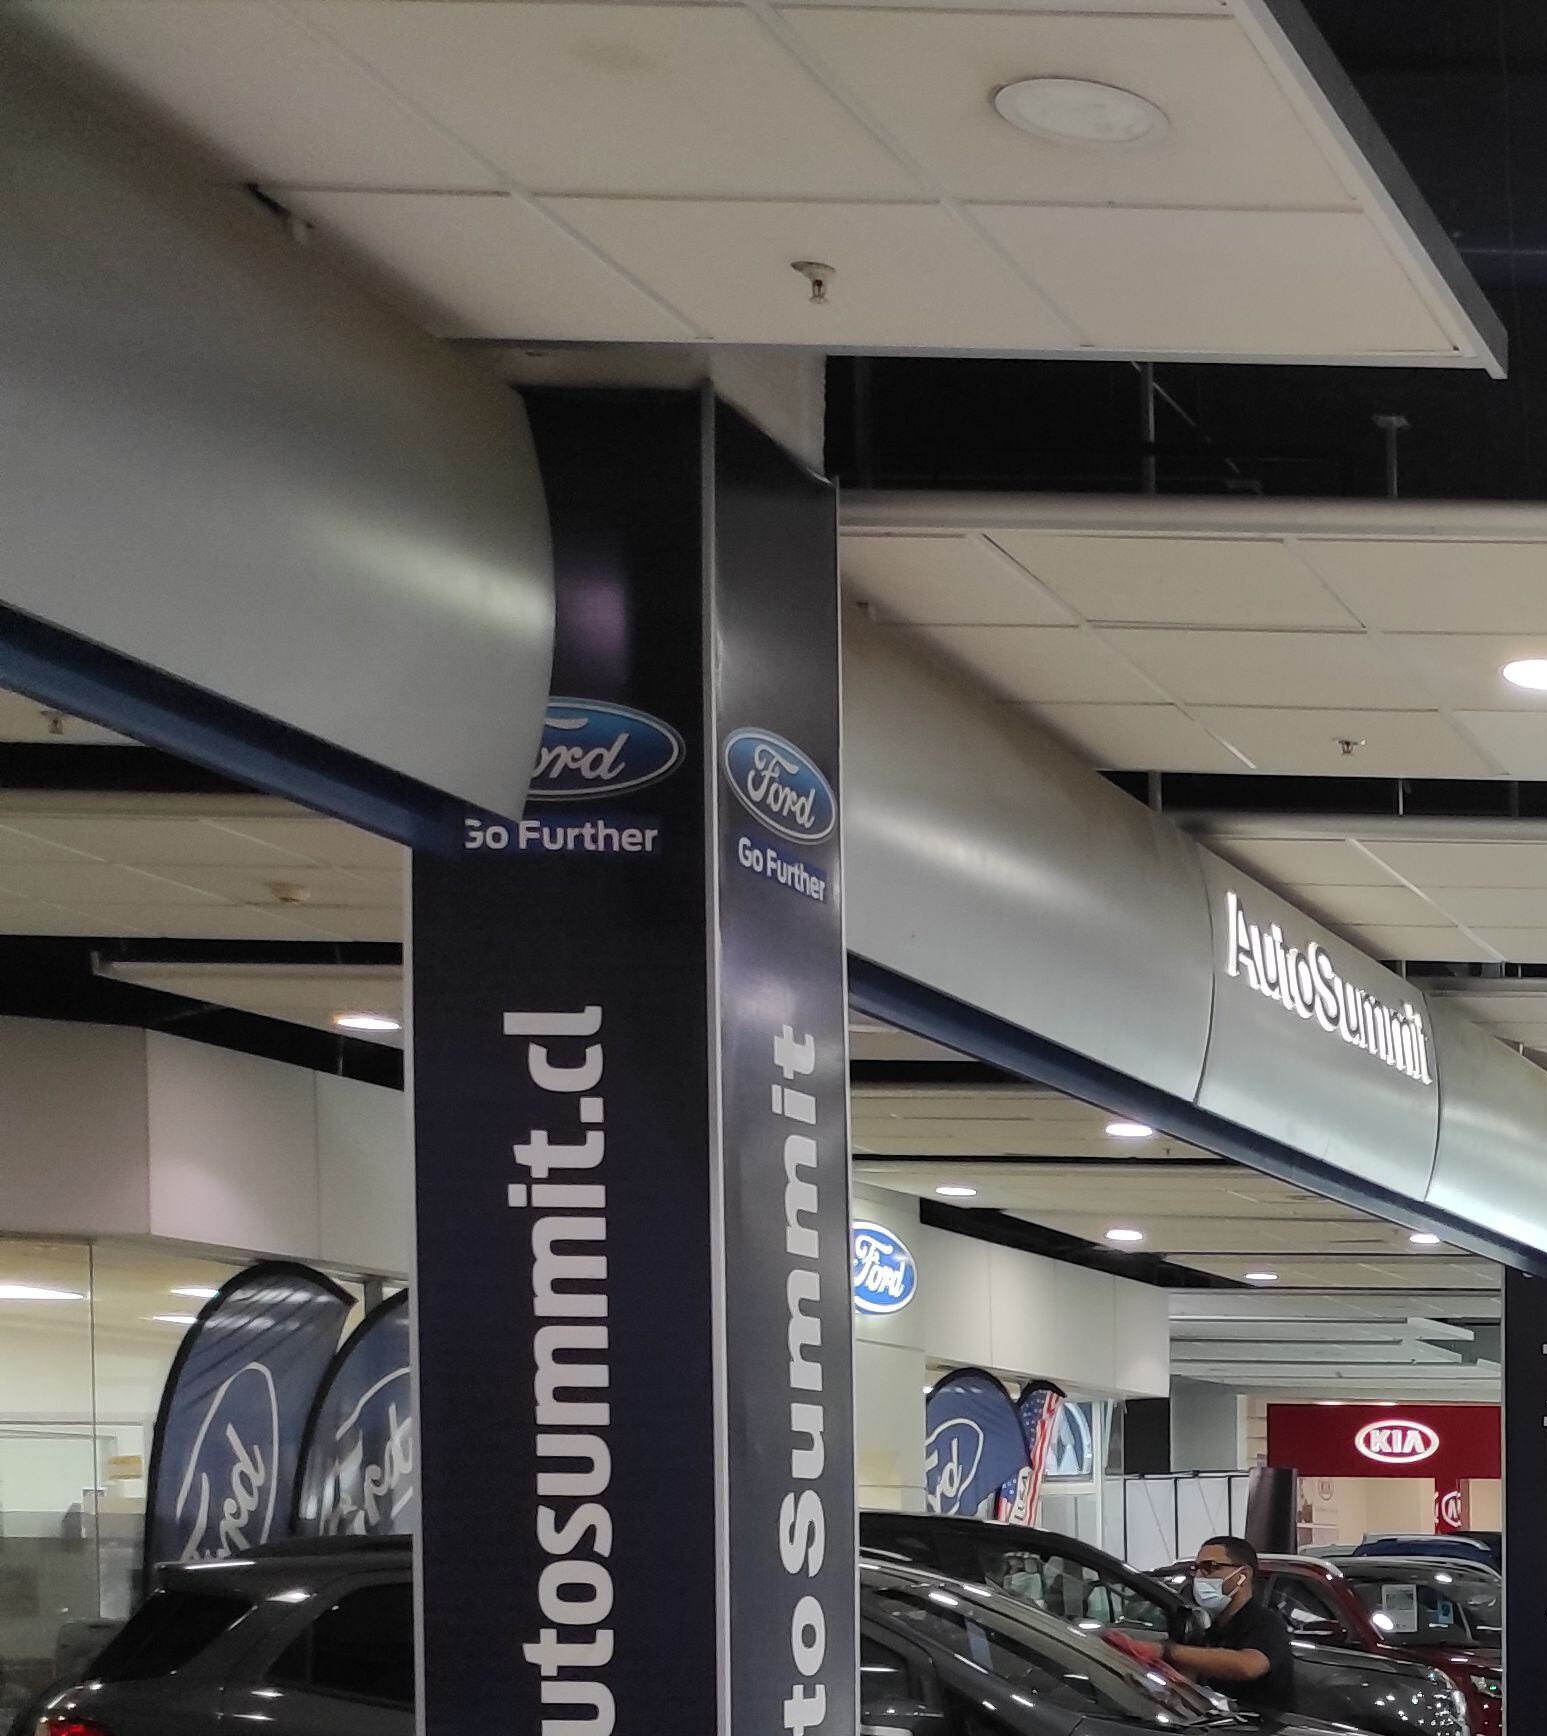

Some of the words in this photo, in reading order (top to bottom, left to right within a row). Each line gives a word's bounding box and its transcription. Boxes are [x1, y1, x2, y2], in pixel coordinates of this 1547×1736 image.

[530, 716, 630, 781] ord
[747, 743, 816, 829] Ford
[518, 819, 659, 853] Further
[738, 836, 764, 874] Go
[766, 846, 826, 902] Further
[1225, 889, 1432, 1085] AutoSummit
[854, 1234, 906, 1298] Ford
[1369, 1429, 1427, 1454] KIA
